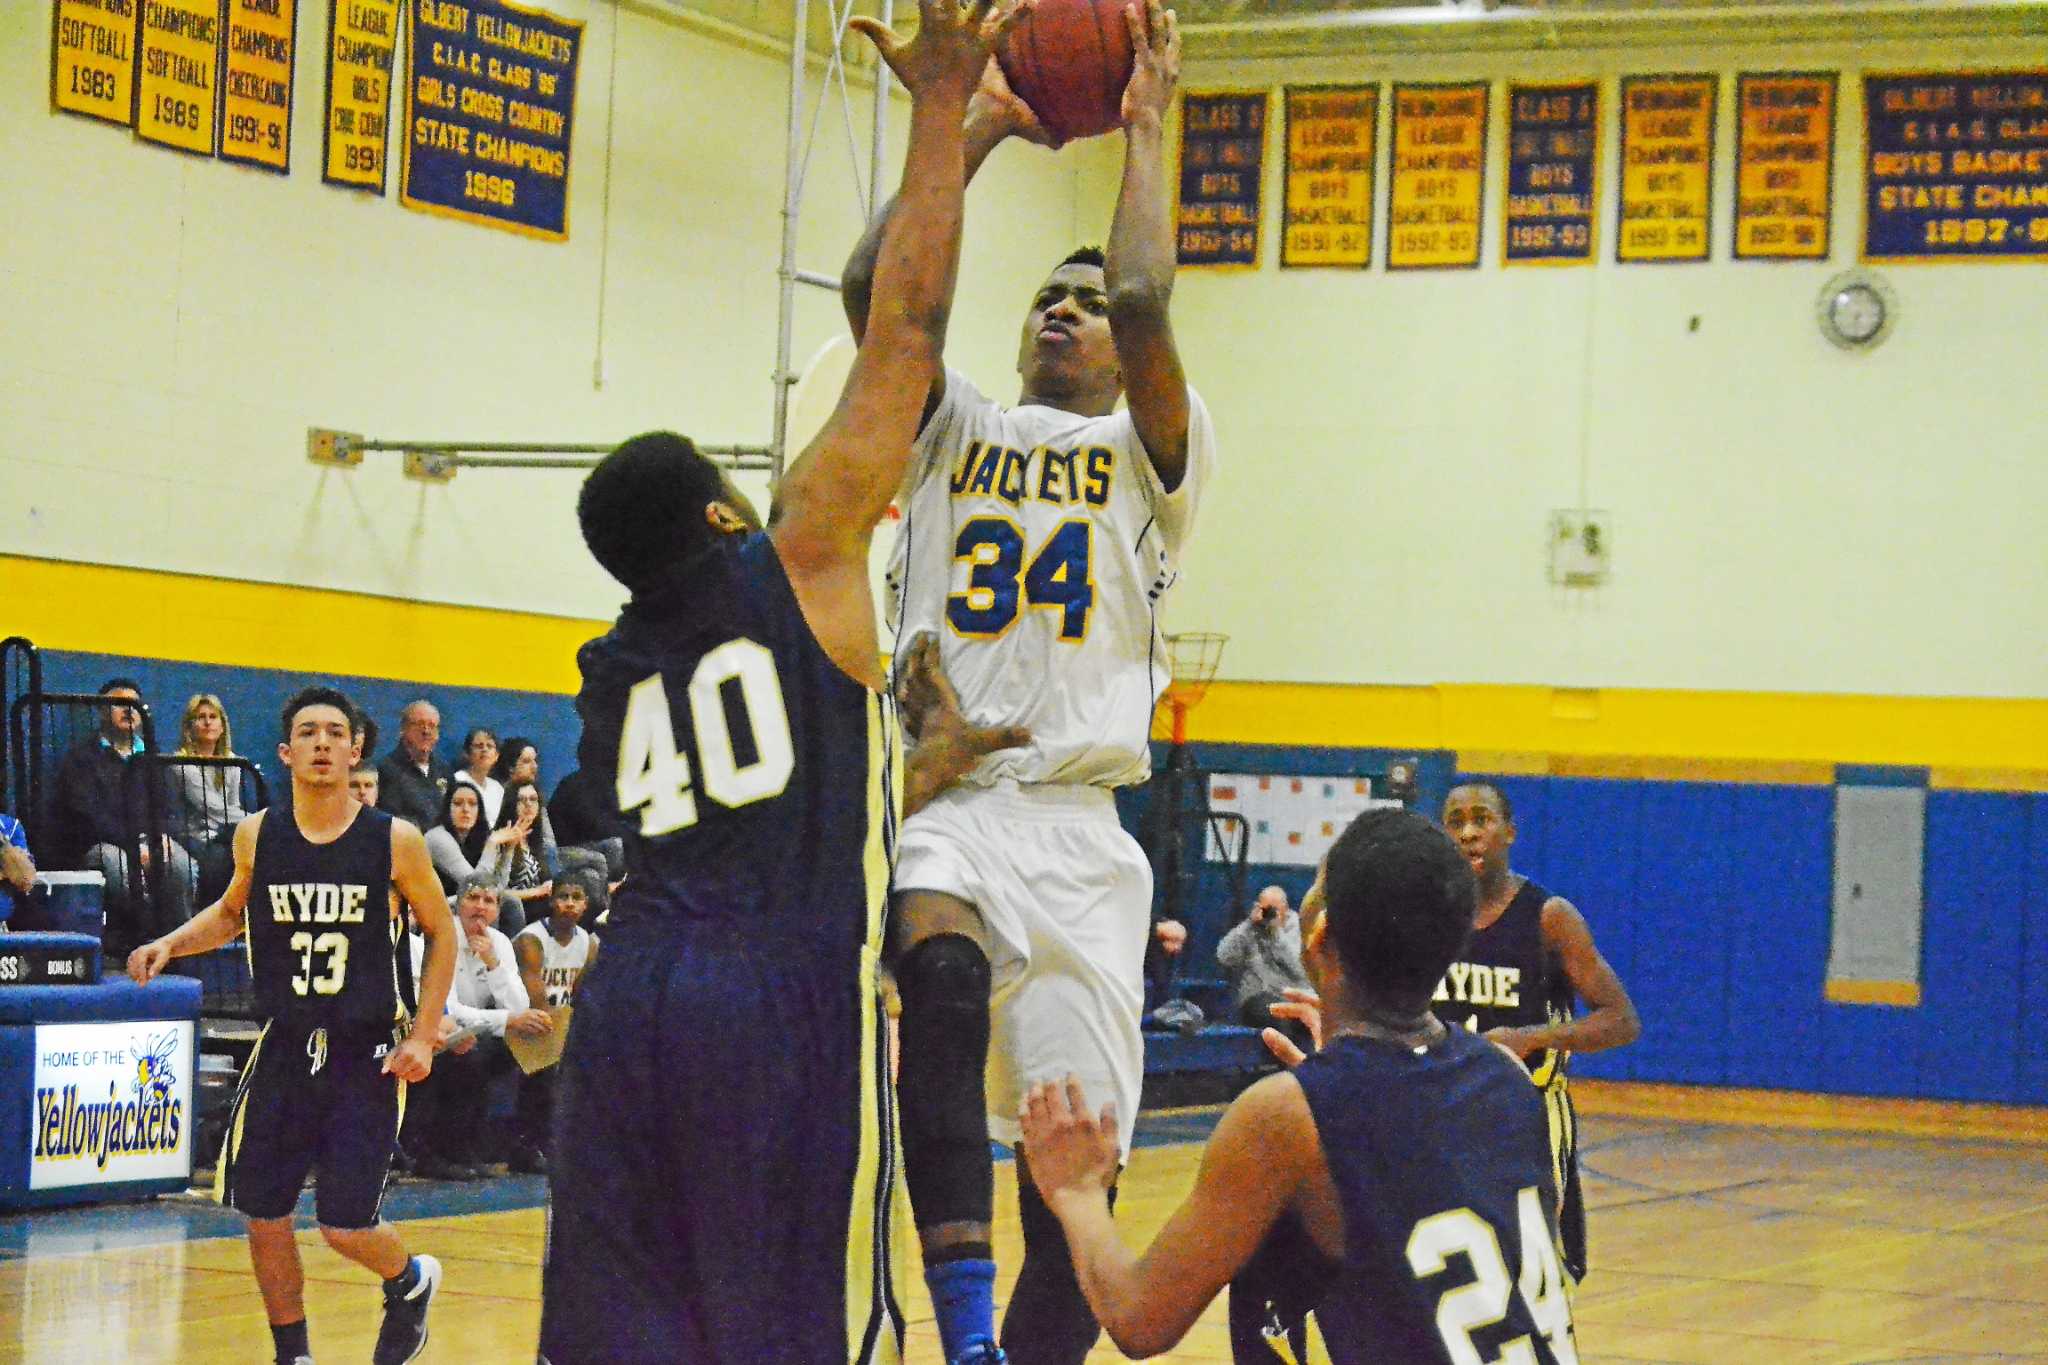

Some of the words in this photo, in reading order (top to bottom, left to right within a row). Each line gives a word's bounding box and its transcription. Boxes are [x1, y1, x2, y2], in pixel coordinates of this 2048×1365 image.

[62, 17, 128, 61] SOFTBALL
[146, 1, 215, 44] CHAMPIONS
[348, 4, 389, 37] LEAGUE
[71, 64, 116, 101] 1983
[146, 46, 209, 89] SOFTBALL
[153, 93, 200, 130] 1989
[415, 117, 470, 155] STATE
[475, 131, 565, 176] CHAMPIONS
[1879, 185, 1963, 211] STATE
[945, 513, 1095, 645] 34
[615, 636, 796, 838] 40
[268, 884, 369, 923] HYDE
[47, 959, 73, 976] BONUS
[290, 931, 350, 996] 33
[42, 1051, 79, 1068] HOME
[82, 1050, 100, 1067] OF
[104, 1050, 126, 1066] THE
[34, 1079, 183, 1173] Yellowjackets
[1405, 1185, 1581, 1365] 24
